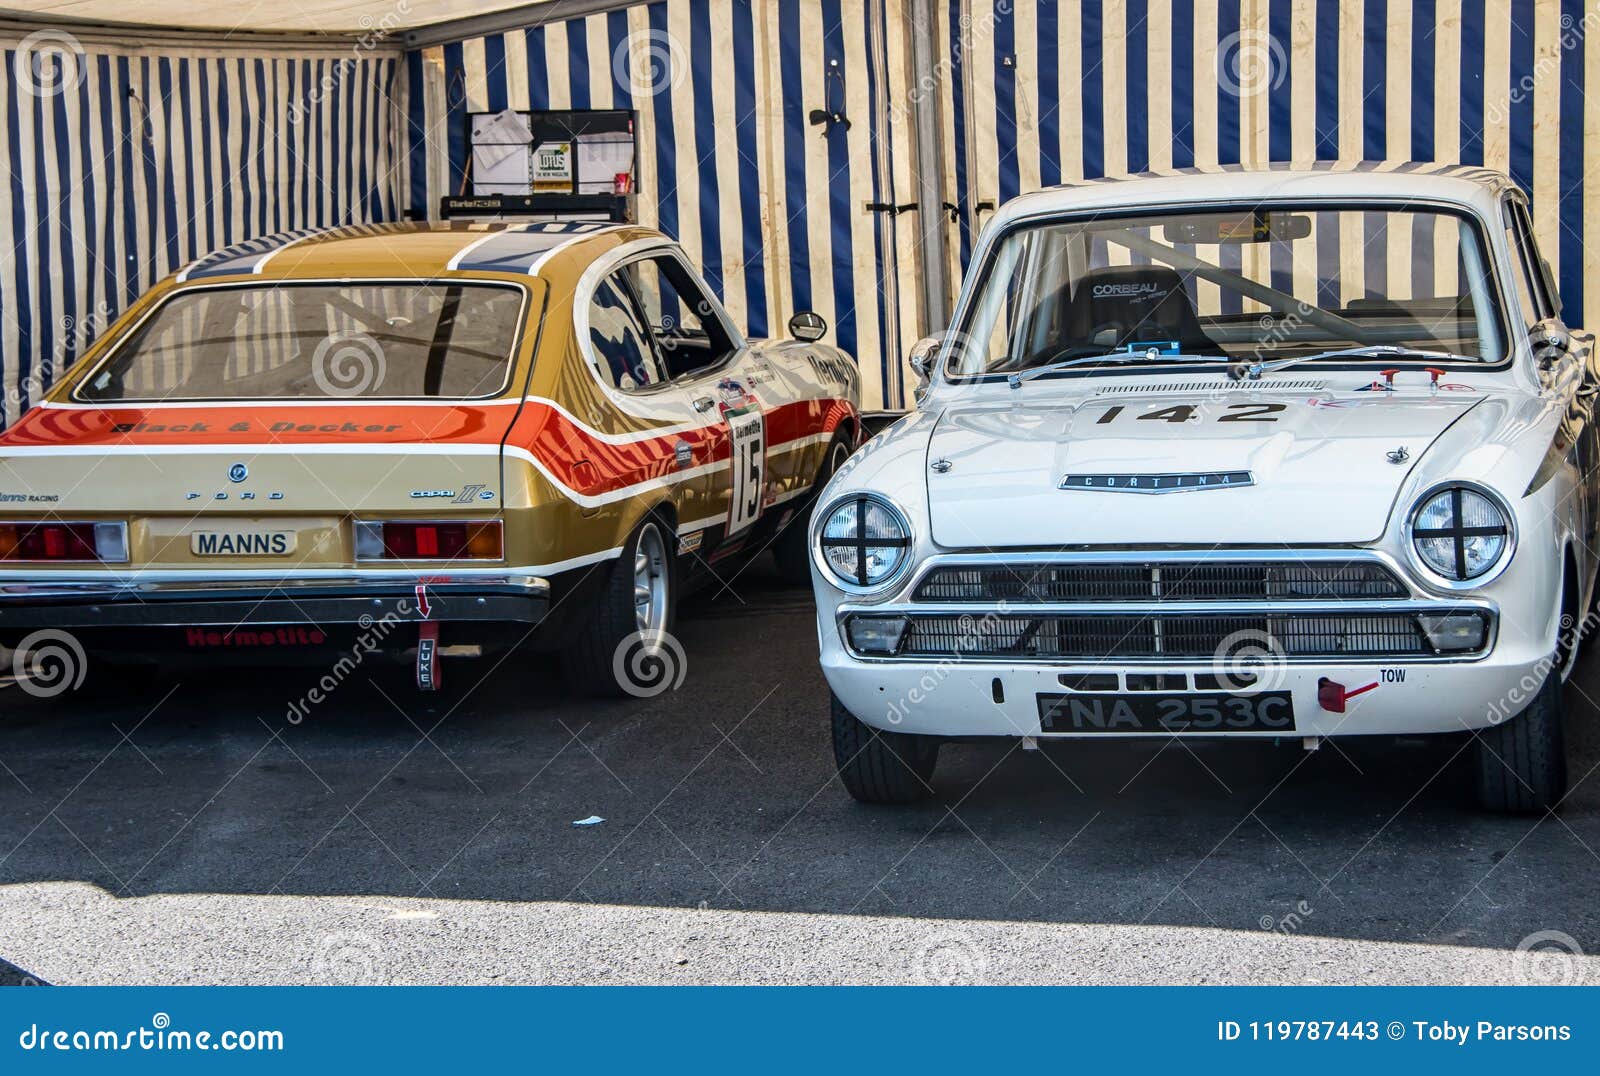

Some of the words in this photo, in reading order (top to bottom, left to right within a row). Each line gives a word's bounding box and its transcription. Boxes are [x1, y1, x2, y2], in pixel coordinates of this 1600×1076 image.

[1093, 283, 1157, 295] CORBEAU
[1096, 403, 1287, 424] 142
[110, 422, 211, 432] Black
[229, 421, 250, 432] &
[269, 421, 402, 432] Decker
[737, 438, 760, 522] 15
[1085, 475, 1230, 487] CORTINA
[186, 491, 284, 500] FORD
[410, 490, 455, 498] CAPRI
[198, 533, 287, 554] MANNS
[421, 642, 431, 682] LUKE
[1381, 669, 1406, 683] TOW
[1042, 699, 1142, 728] FNA
[1156, 698, 1291, 728] 253C
